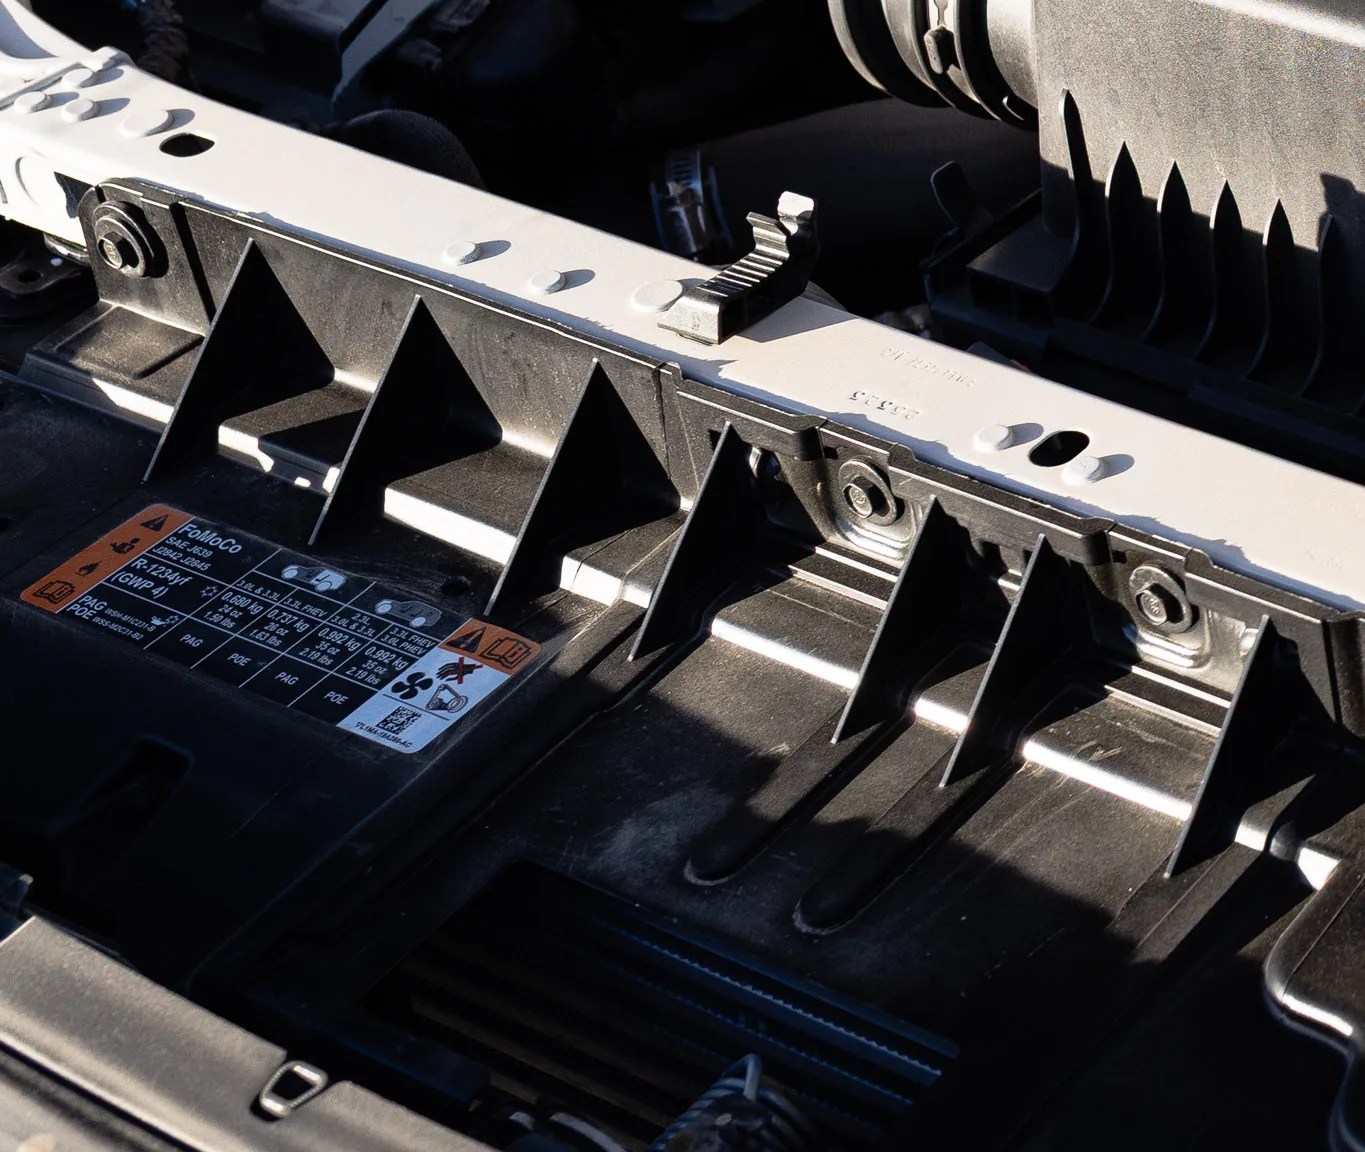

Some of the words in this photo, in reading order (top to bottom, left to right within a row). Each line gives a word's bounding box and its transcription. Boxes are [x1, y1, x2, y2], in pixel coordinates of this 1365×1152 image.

[165, 536, 188, 549] SAE
[187, 542, 214, 559] J639
[178, 523, 243, 554] FoMoCo
[152, 546, 183, 562] J2842
[180, 556, 212, 572] J2845
[130, 557, 193, 586] R-1234yf
[110, 570, 153, 591] (GWP
[151, 585, 169, 600] 4)
[236, 579, 253, 591] 3.0L
[254, 586, 263, 594] &
[262, 589, 281, 601] 3.3L
[66, 603, 97, 620] POE
[78, 595, 107, 611] PAG
[218, 604, 230, 614] 24
[230, 609, 243, 619] oz
[221, 591, 251, 608] 0.680
[247, 601, 264, 615] kg
[283, 597, 301, 610] 3.3L
[301, 604, 329, 618] FHEV
[203, 611, 221, 623] 1.50
[219, 616, 237, 629] lbs
[264, 622, 277, 632] 26
[277, 627, 290, 636] oz
[267, 609, 298, 625] 0.737
[293, 619, 311, 633] kg
[330, 615, 348, 627] 3.0L
[349, 622, 357, 630] &
[357, 624, 377, 637] 3.3L
[180, 633, 204, 648] PAG
[249, 629, 267, 641] 1.63
[266, 634, 283, 647] lbs
[317, 627, 348, 645] 0.992
[344, 638, 362, 652] kg
[381, 634, 399, 647] 3.0L
[399, 642, 427, 656] PHEV
[389, 626, 408, 640] 3.3L
[408, 634, 436, 648] FHEV
[299, 647, 318, 660] 2.19
[317, 653, 334, 666] lbs
[315, 640, 328, 651] 35
[328, 645, 341, 655] oz
[227, 652, 252, 667] POE
[361, 659, 375, 669] 35
[374, 664, 388, 675] oz
[364, 646, 397, 665] 0.992
[392, 657, 411, 672] kg
[274, 671, 300, 687] PAG
[345, 666, 366, 679] 2.19
[364, 672, 381, 685] lbs
[323, 691, 349, 706] POE
